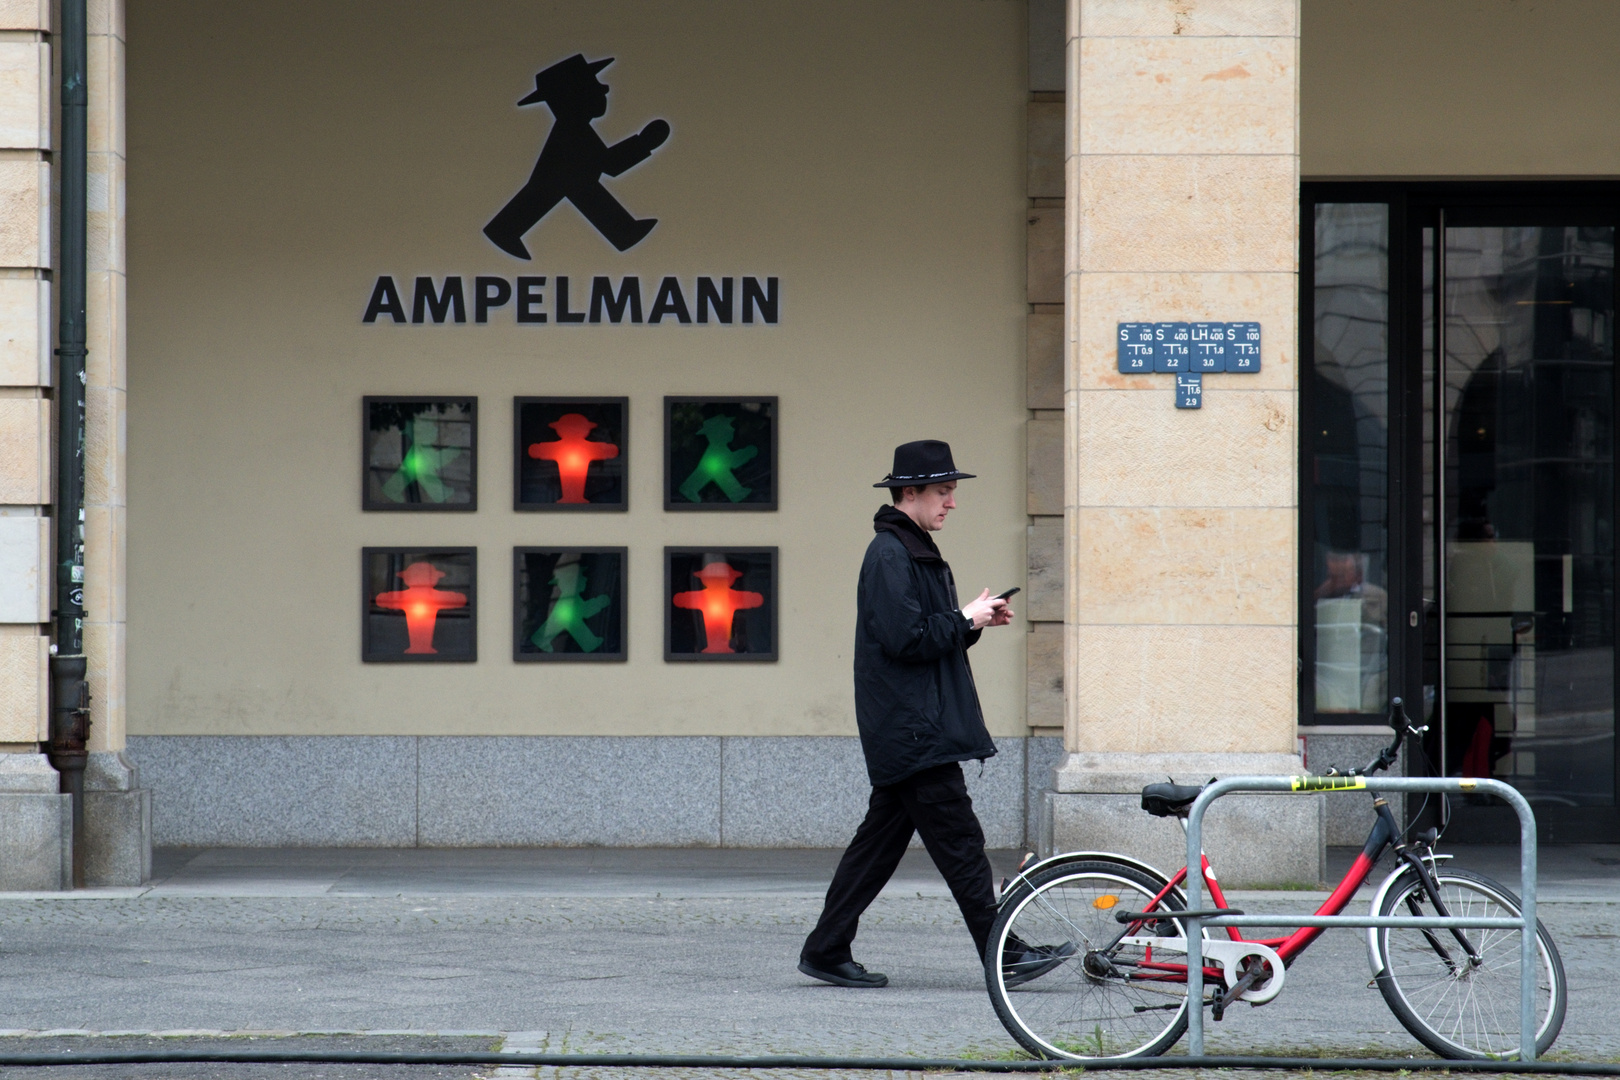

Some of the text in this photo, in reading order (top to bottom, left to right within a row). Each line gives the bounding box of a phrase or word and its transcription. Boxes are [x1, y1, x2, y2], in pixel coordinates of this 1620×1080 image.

[362, 276, 779, 323] AMPELMANN
[1120, 329, 1153, 341] S 100
[1155, 329, 1188, 341] S 400
[1191, 329, 1208, 341] LH
[1209, 333, 1224, 341] 400
[1227, 329, 1260, 341] S 100
[1131, 359, 1143, 367] 2.9
[1167, 359, 1179, 367] 2.2
[1202, 358, 1214, 367] 3.0
[1238, 358, 1250, 367] 2.9
[1177, 376, 1182, 384] S
[1185, 398, 1197, 406] 2.9
